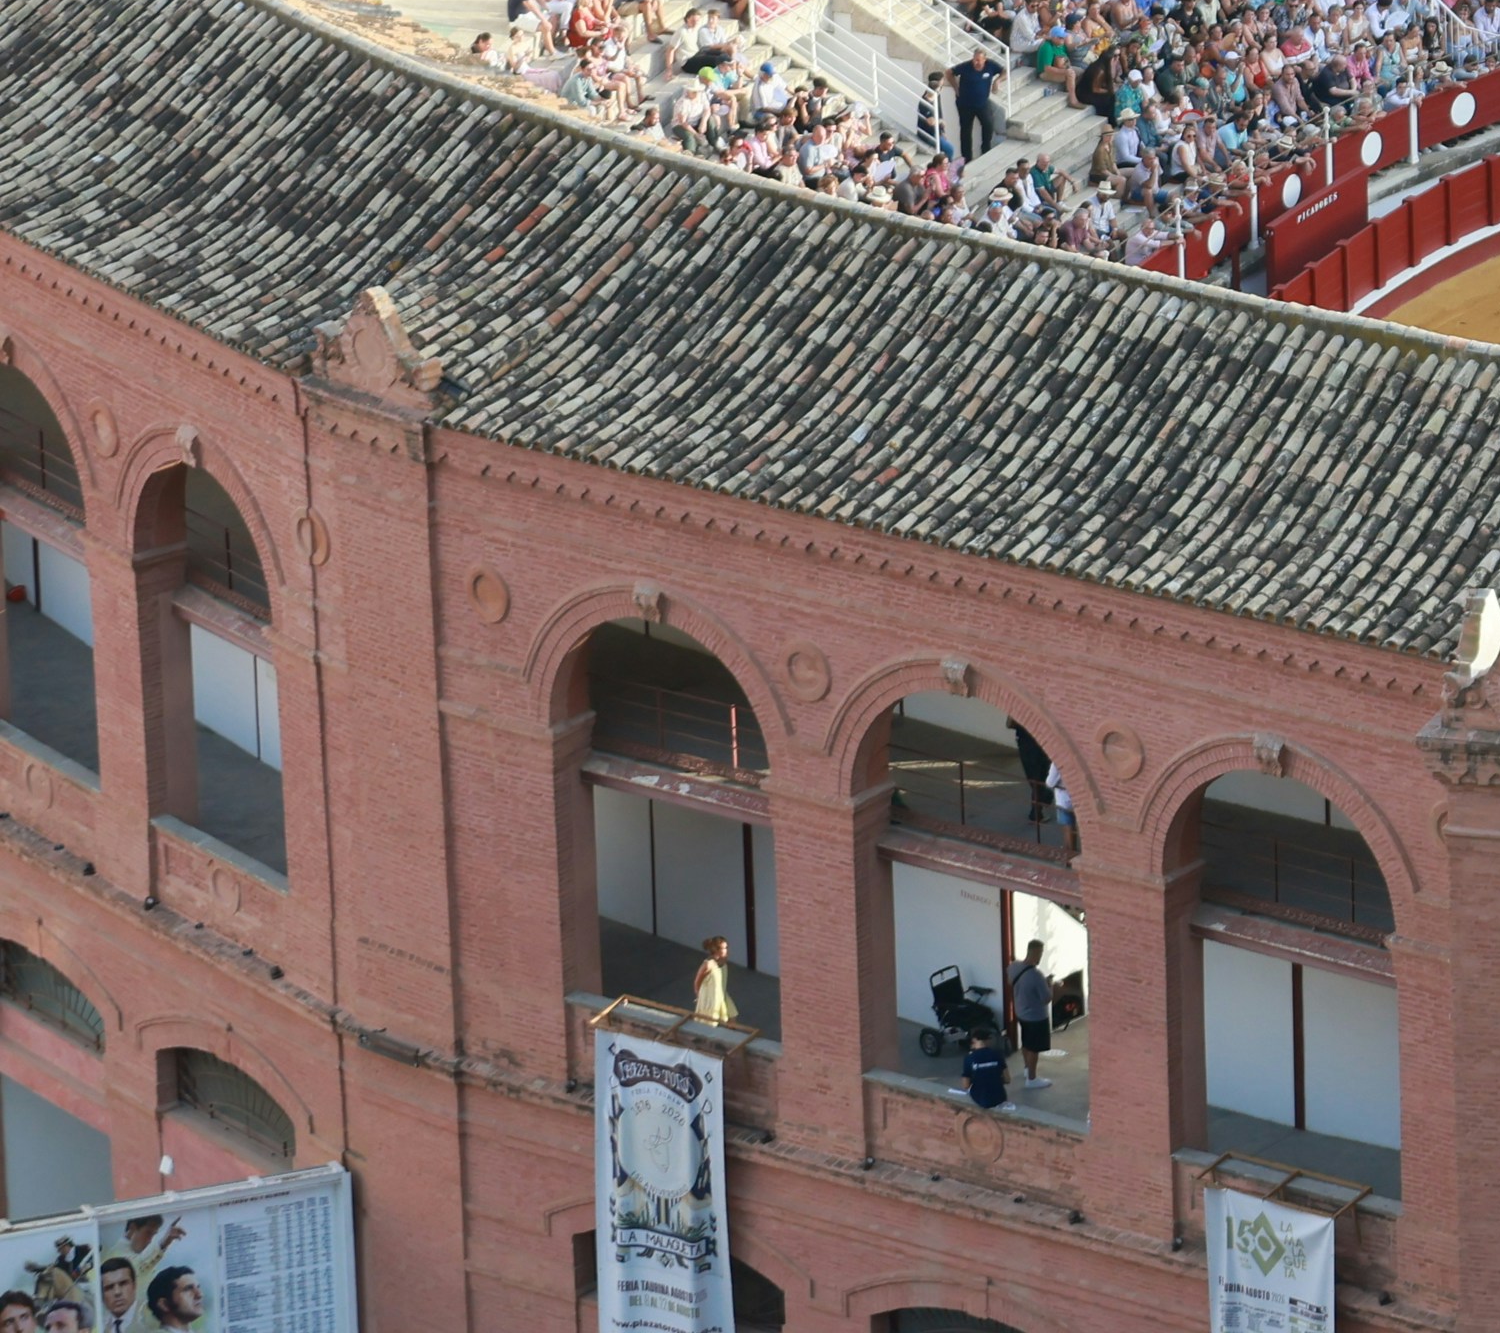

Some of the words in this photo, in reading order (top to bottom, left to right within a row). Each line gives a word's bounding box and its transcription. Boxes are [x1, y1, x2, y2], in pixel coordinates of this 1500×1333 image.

[1296, 191, 1338, 224] PICADORES
[1281, 1221, 1293, 1233] LA
[620, 1231, 637, 1243] LA
[1284, 1235, 1304, 1249] MA
[1292, 1247, 1306, 1259] LA
[1283, 1255, 1307, 1271] GUE
[1284, 1267, 1297, 1281] TA
[1246, 1287, 1271, 1301] AGOSTO
